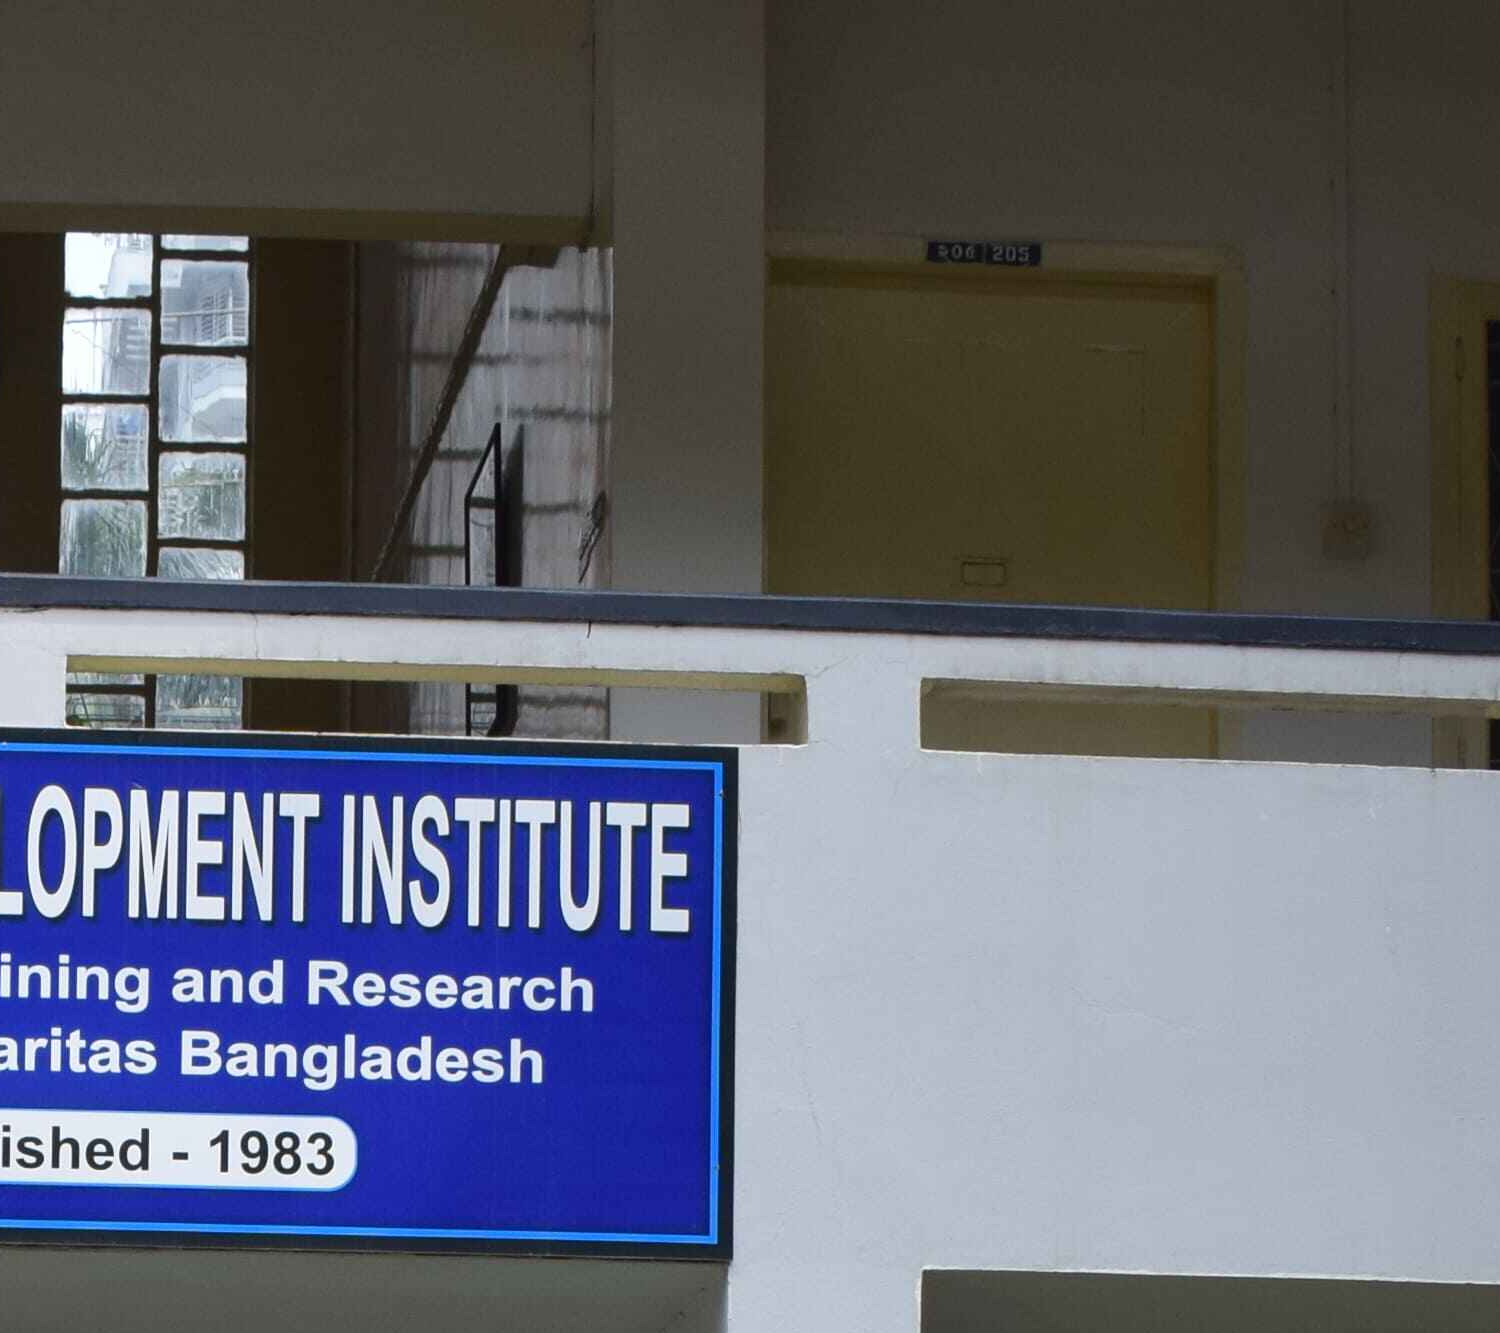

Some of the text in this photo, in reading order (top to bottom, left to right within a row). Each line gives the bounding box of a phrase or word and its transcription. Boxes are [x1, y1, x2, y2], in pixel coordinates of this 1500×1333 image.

[341, 793, 691, 934] INSTITUTE
[170, 958, 285, 1006] and
[307, 958, 595, 1013] Research
[179, 1028, 544, 1092] Bangladesh
[209, 1129, 336, 1177] 1983
